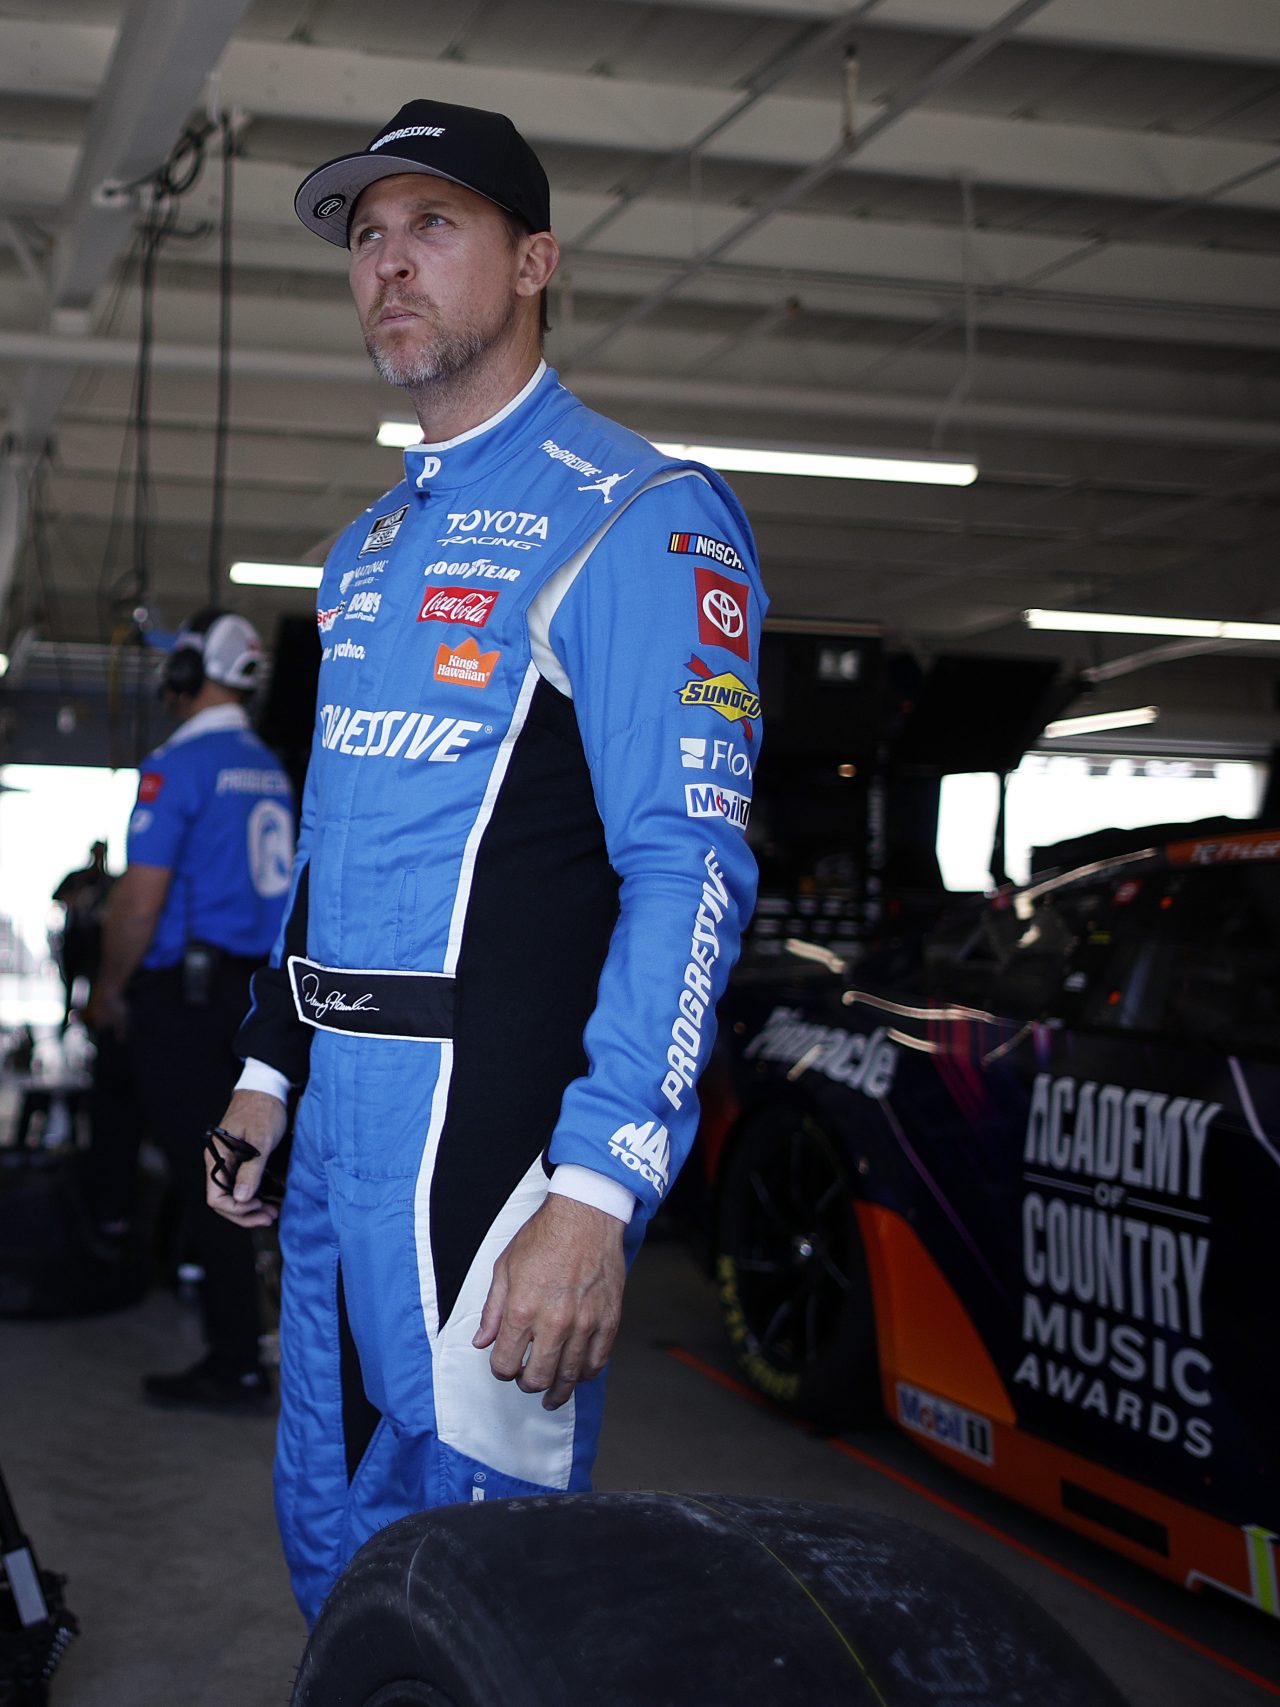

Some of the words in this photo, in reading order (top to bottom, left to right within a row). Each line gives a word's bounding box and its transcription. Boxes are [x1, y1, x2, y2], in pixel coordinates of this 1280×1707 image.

[436, 535, 542, 551] RACING
[447, 509, 550, 541] TOYOTA
[424, 558, 521, 582] GOODYEAR
[695, 534, 745, 570] NASCA
[437, 664, 486, 682] Hawaiian
[448, 654, 479, 670] King's
[685, 683, 761, 715] SUNOCO
[661, 846, 729, 1111] PROGRESSIVE
[1024, 1072, 1223, 1200] ACADEMY
[608, 1140, 664, 1199] TOOL
[1093, 1181, 1128, 1208] OF
[1023, 1193, 1211, 1340] COUNTRY
[1023, 1295, 1214, 1407] MUSIC
[899, 1387, 963, 1445] Mobil
[1014, 1352, 1214, 1459] AWARDS
